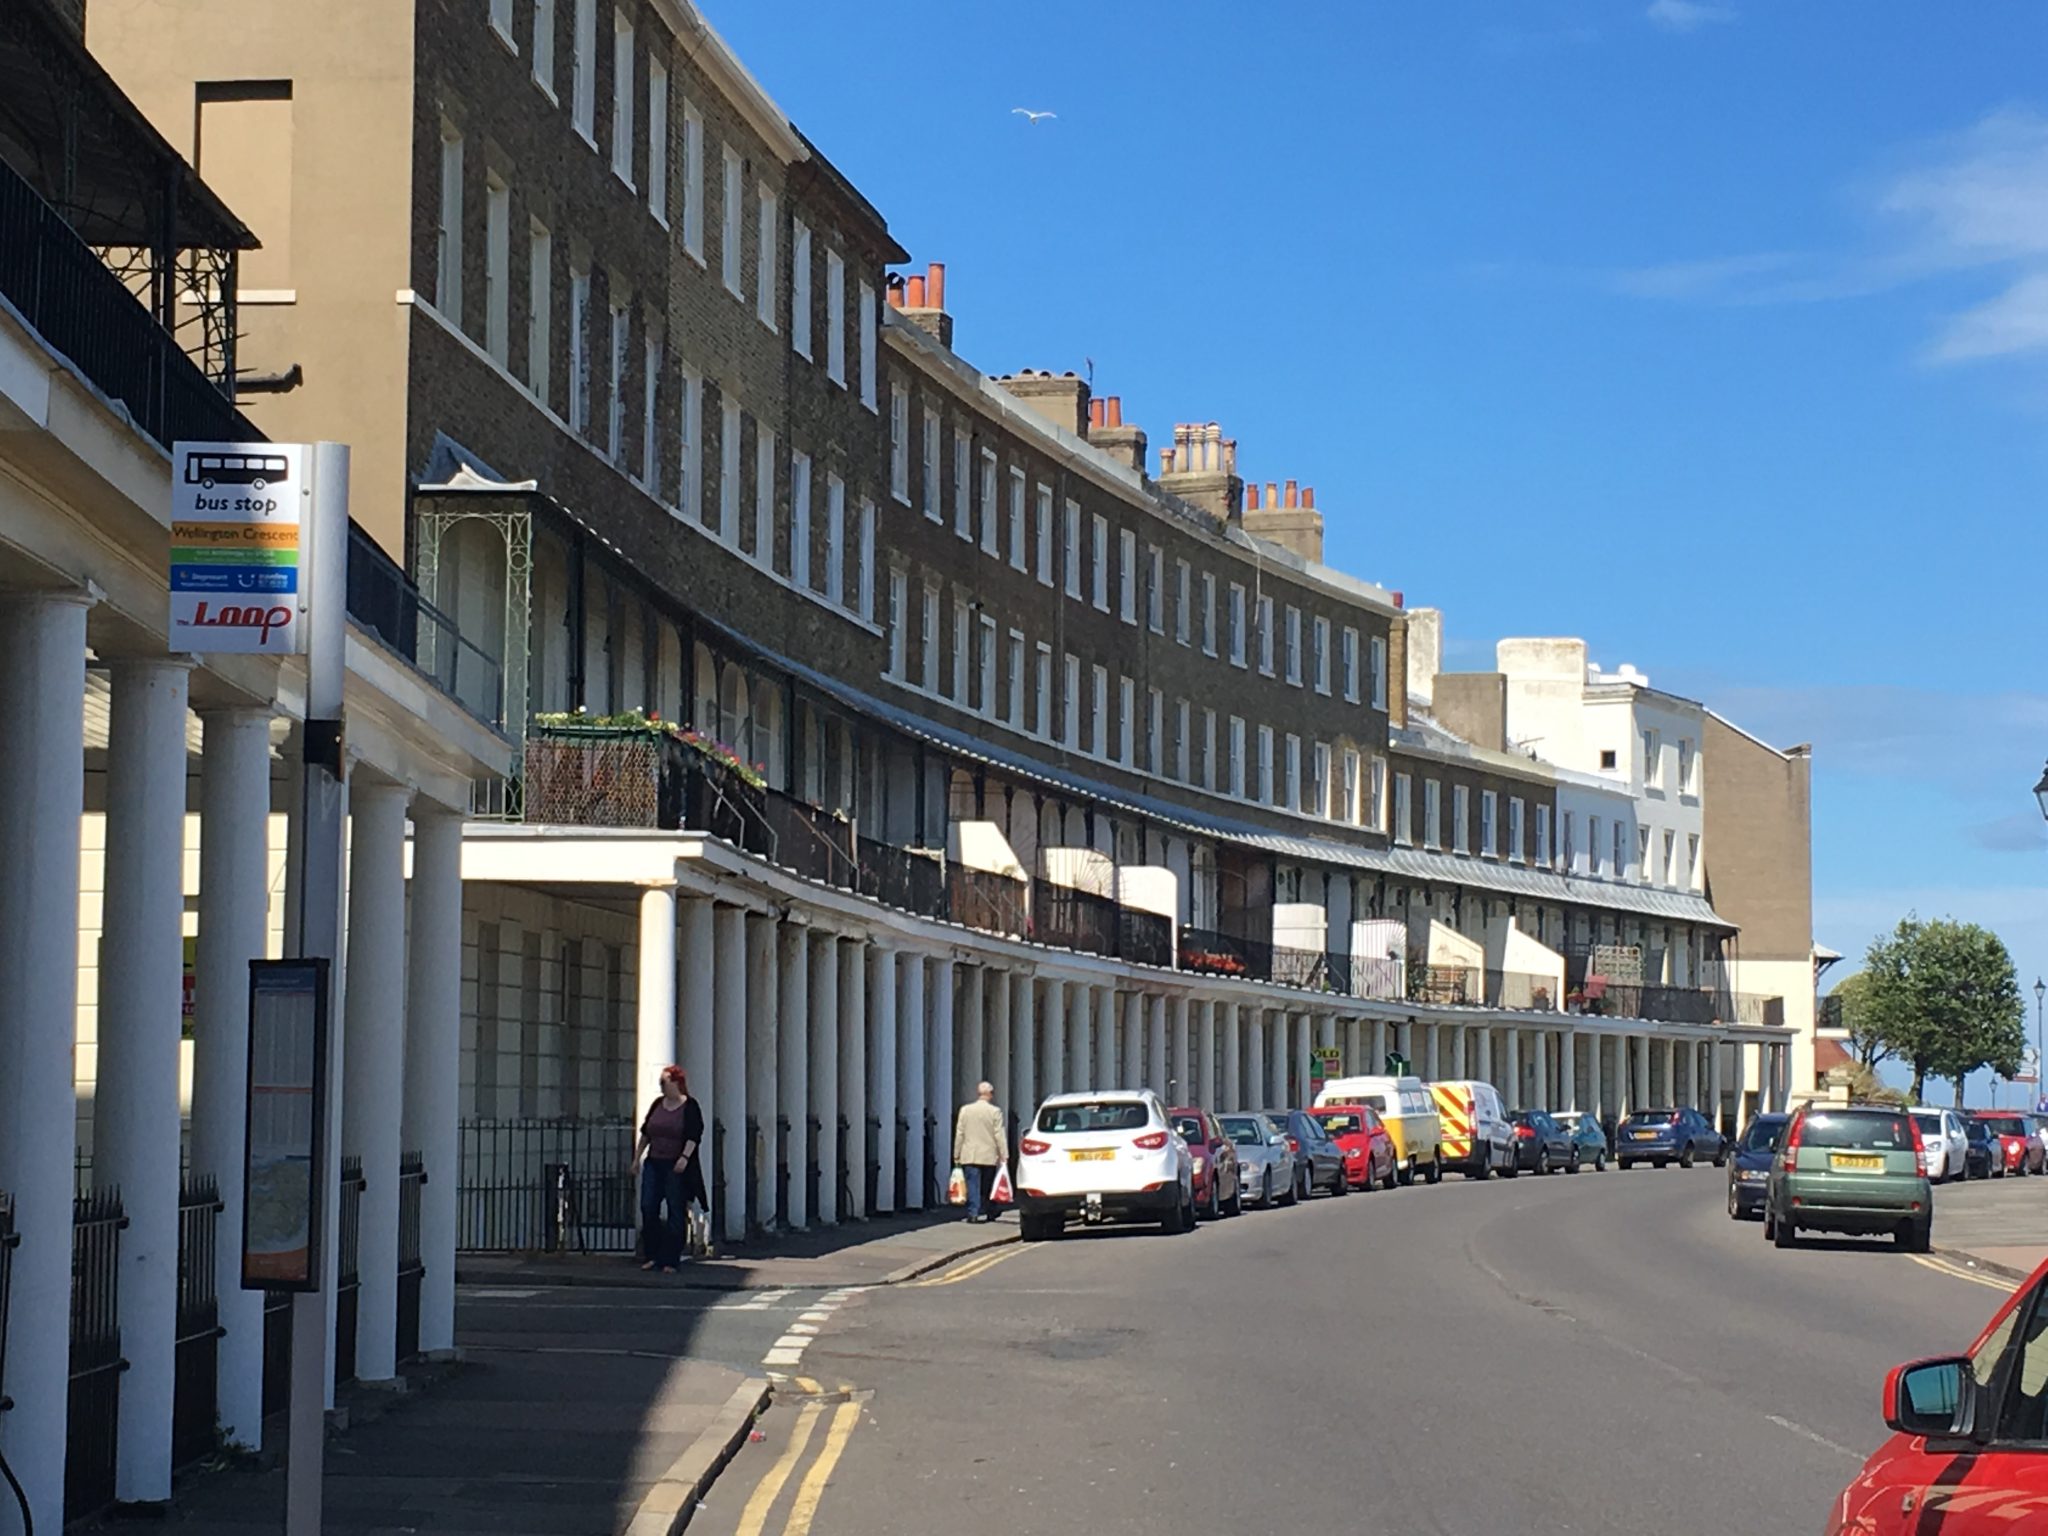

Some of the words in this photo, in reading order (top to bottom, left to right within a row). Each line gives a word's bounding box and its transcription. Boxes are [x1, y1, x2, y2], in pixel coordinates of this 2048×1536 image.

[195, 494, 228, 511] bus
[234, 496, 277, 516] stop
[174, 527, 239, 541] Wellington
[243, 528, 299, 541] Crescent
[194, 602, 292, 645] Loop
[1313, 1048, 1339, 1059] OLD
